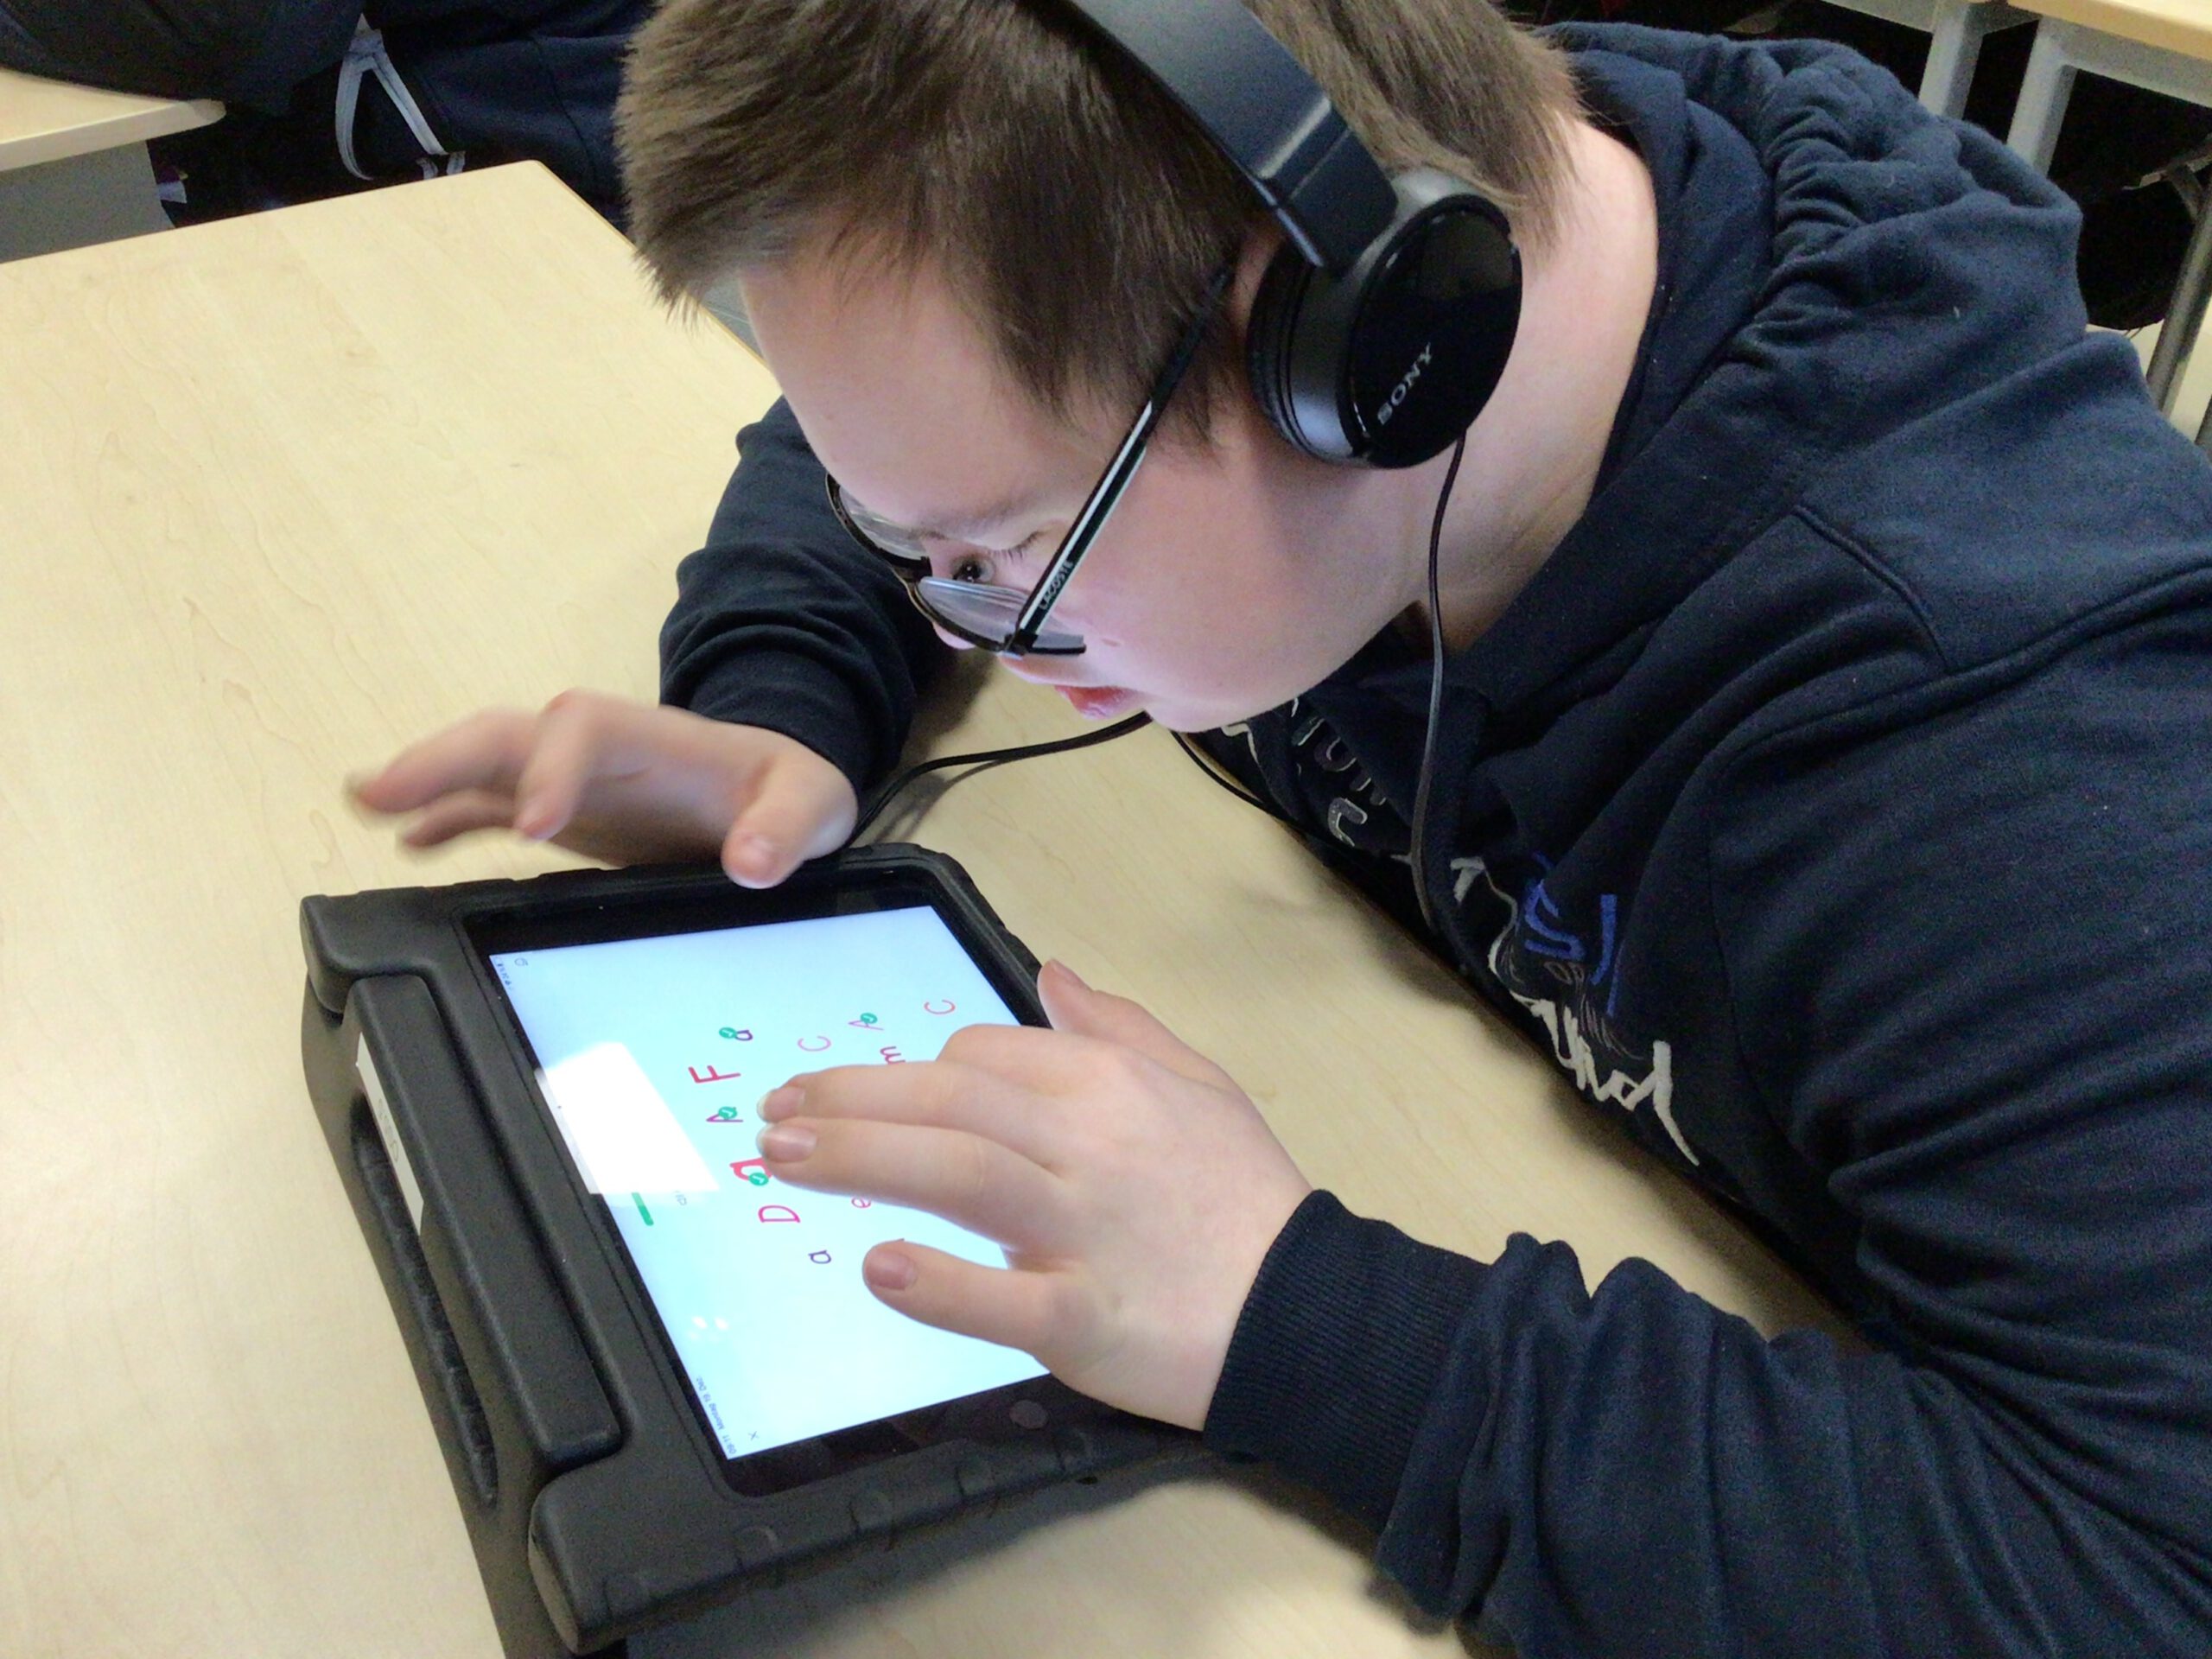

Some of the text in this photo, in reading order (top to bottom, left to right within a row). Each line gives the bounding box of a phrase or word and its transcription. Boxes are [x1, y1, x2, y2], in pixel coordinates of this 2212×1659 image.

[1377, 342, 1431, 424] SONY
[689, 1065, 741, 1084] F
[706, 1107, 743, 1122] A
[758, 1205, 800, 1223] D
[808, 1249, 832, 1264] a
